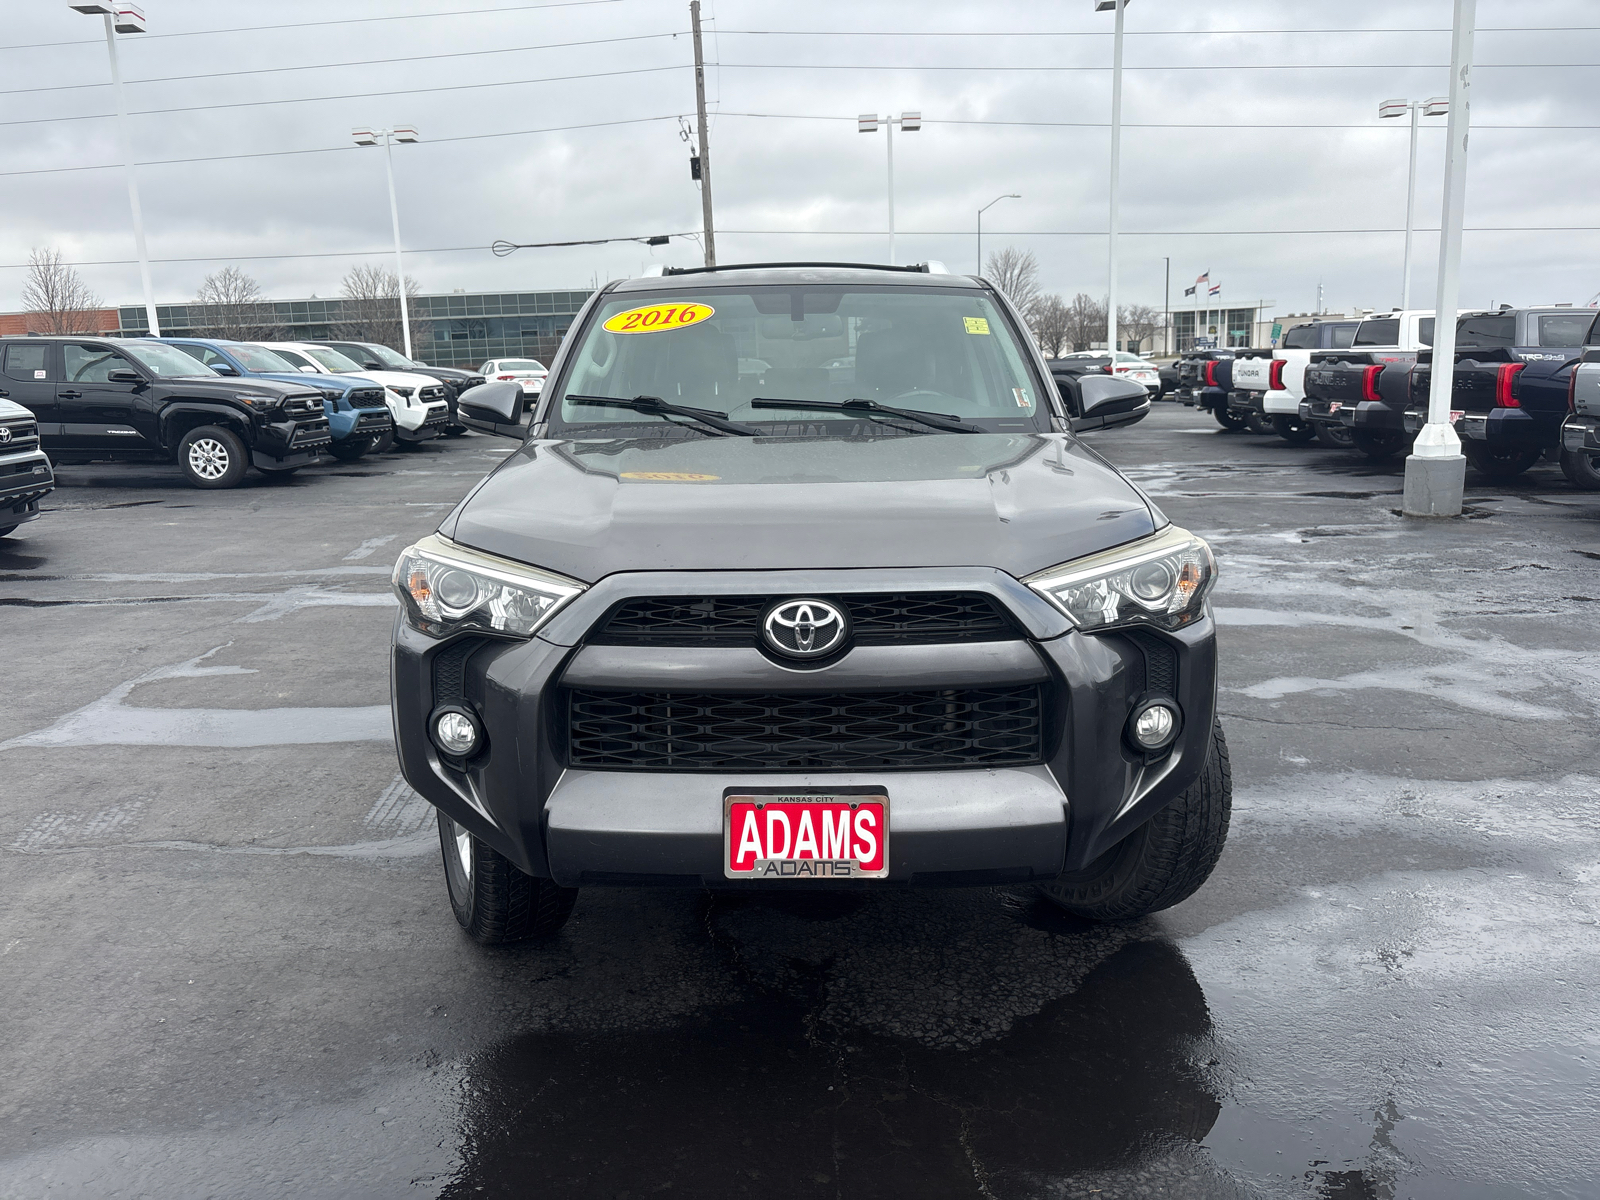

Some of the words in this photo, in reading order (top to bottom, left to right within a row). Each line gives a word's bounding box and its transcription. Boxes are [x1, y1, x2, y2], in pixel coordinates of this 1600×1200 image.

[621, 304, 698, 331] 2016
[1238, 369, 1260, 377] TUNDRA
[736, 809, 877, 863] ADAMS
[763, 861, 851, 876] ADAMS
